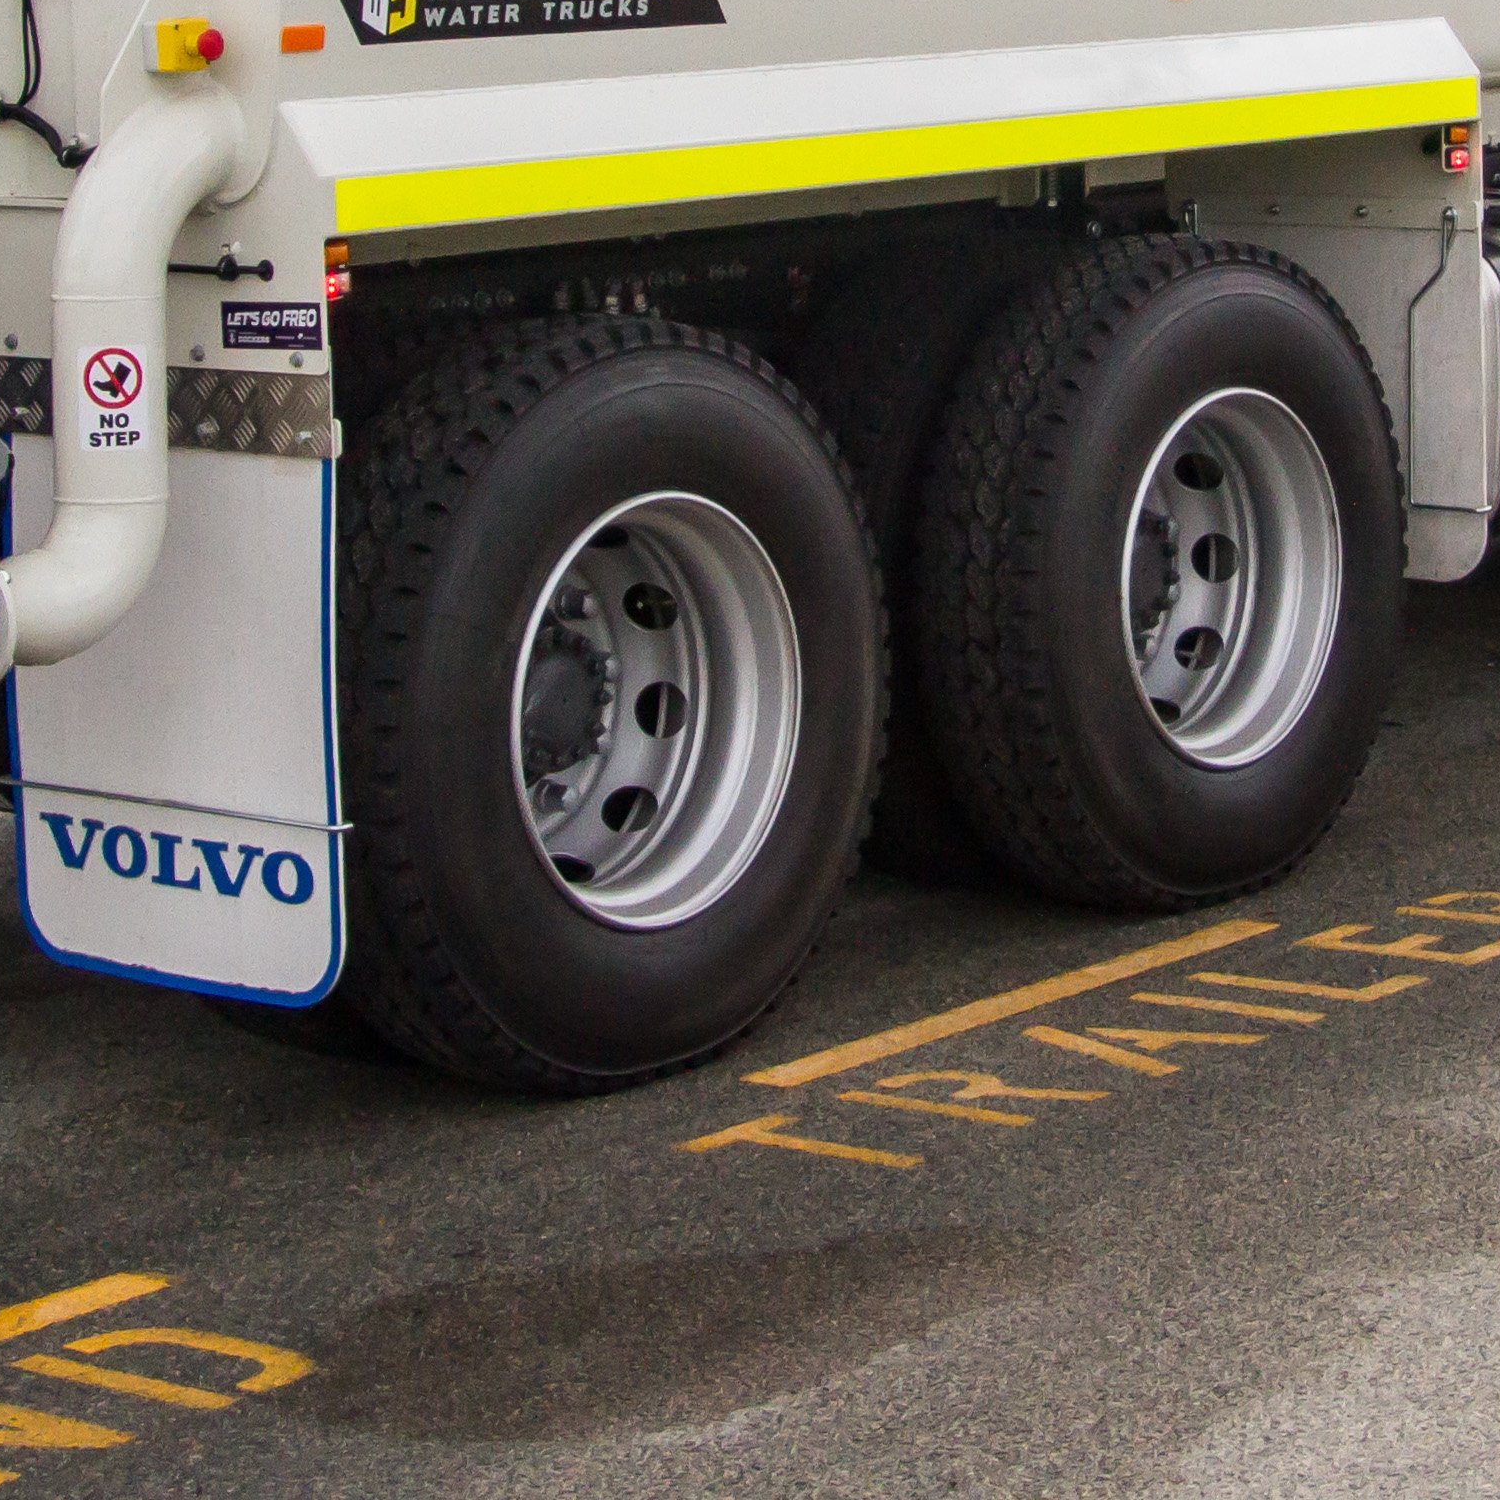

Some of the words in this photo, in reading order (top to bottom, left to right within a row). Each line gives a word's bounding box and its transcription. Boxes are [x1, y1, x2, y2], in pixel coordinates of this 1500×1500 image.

[424, 5, 520, 28] WATER
[227, 311, 260, 326] LET'S
[261, 310, 281, 327] GO
[281, 308, 318, 328] FREO
[99, 413, 130, 429] NO
[89, 430, 141, 448] STEP
[39, 811, 315, 906] VOLVO
